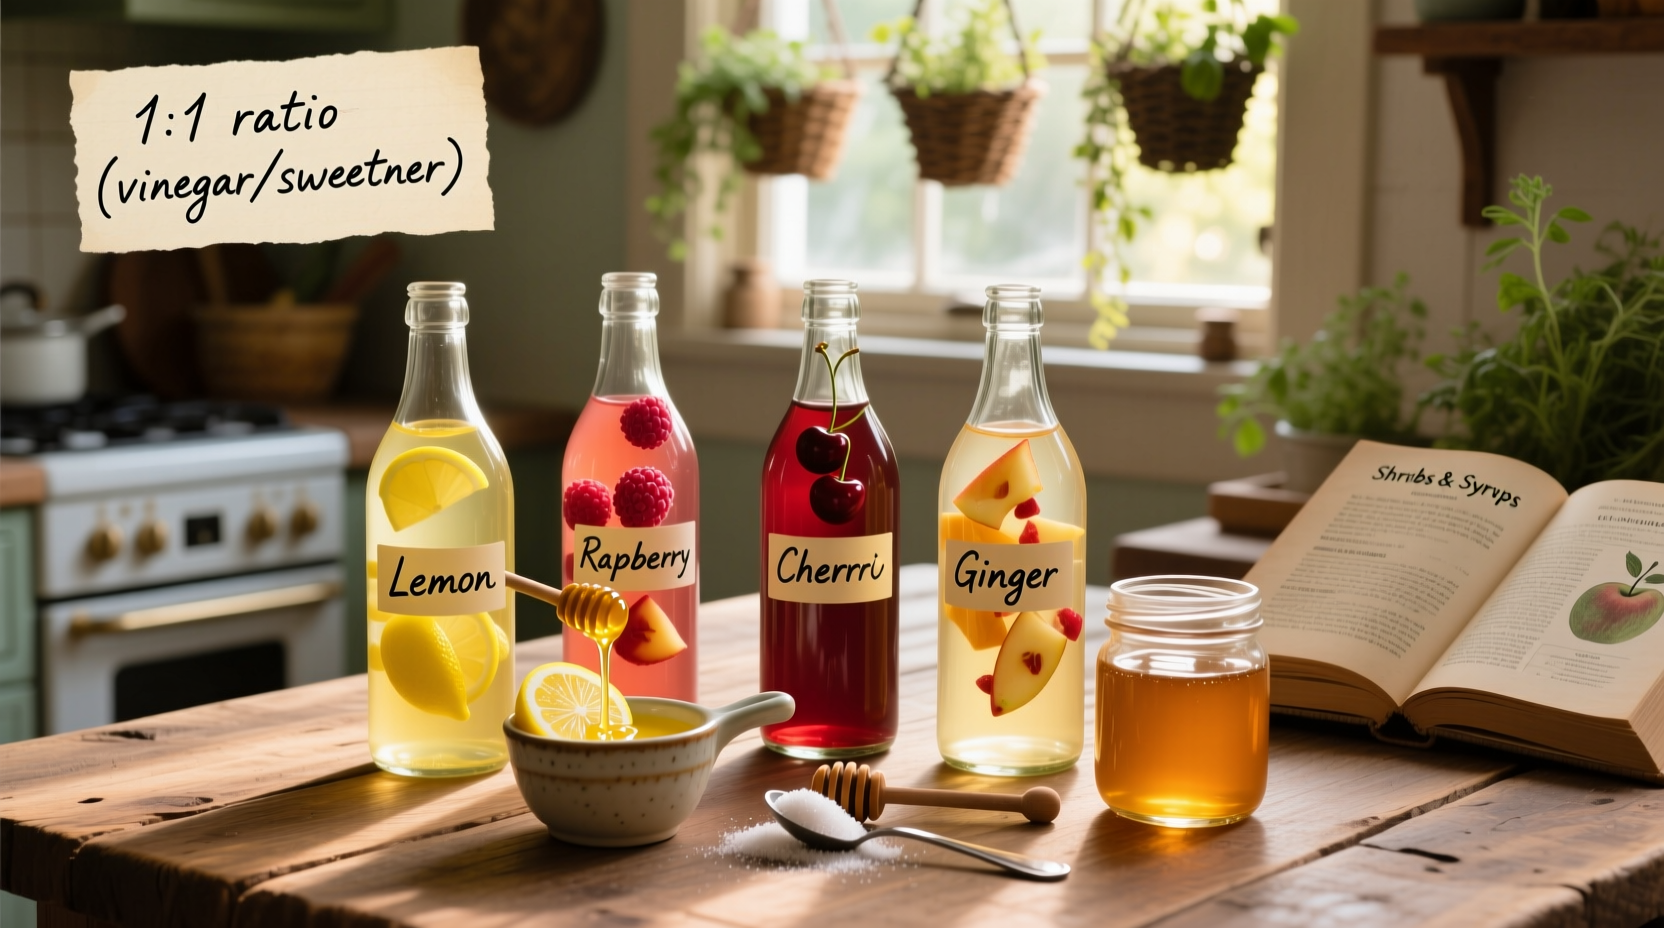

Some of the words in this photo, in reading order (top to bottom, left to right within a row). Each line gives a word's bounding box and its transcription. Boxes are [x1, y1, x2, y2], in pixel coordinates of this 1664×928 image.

[135, 92, 207, 145] 1:1
[232, 90, 338, 136] ratio
[97, 136, 464, 224] (vinegar/sweetner)
[1438, 471, 1454, 488] &
[388, 555, 497, 598] Lemon
[579, 535, 691, 582] Rapberry
[954, 549, 1059, 607] Ginger
